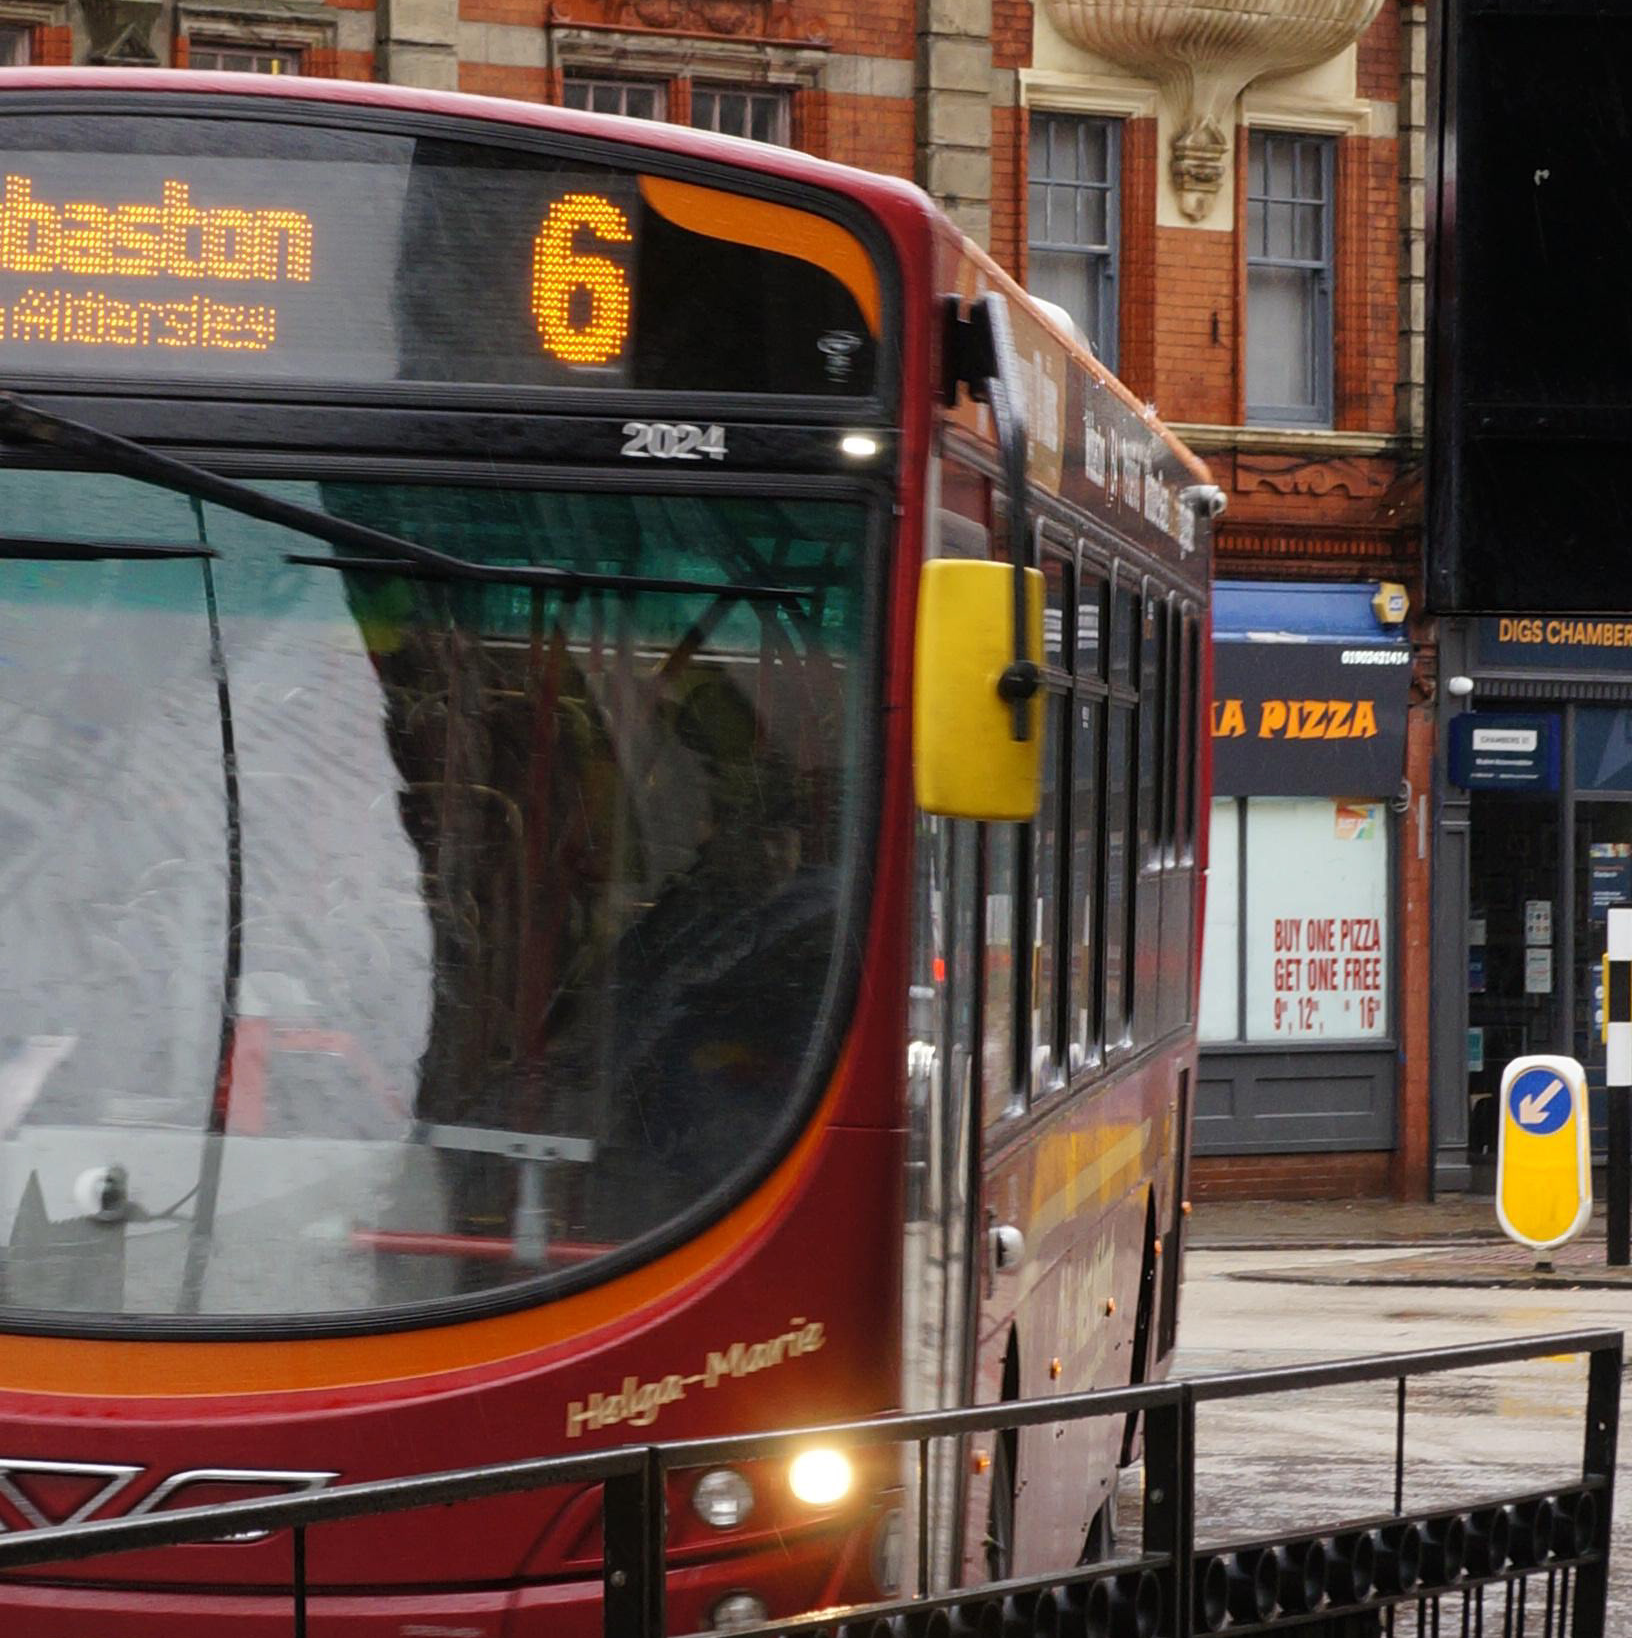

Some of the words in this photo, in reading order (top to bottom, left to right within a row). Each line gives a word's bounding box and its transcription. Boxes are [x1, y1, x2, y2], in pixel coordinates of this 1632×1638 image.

[531, 193, 633, 363] 6
[620, 422, 729, 461] 2024
[1498, 618, 1544, 644] DIGS
[1258, 699, 1379, 740] PIZZA
[1274, 918, 1302, 952] BUY
[1306, 918, 1336, 952] ONE
[1340, 918, 1381, 952] PIZZA
[1274, 958, 1302, 991] GET
[1307, 958, 1338, 991] ONE
[1344, 958, 1381, 991] FREE
[565, 1316, 827, 1438] Helga-Marie
